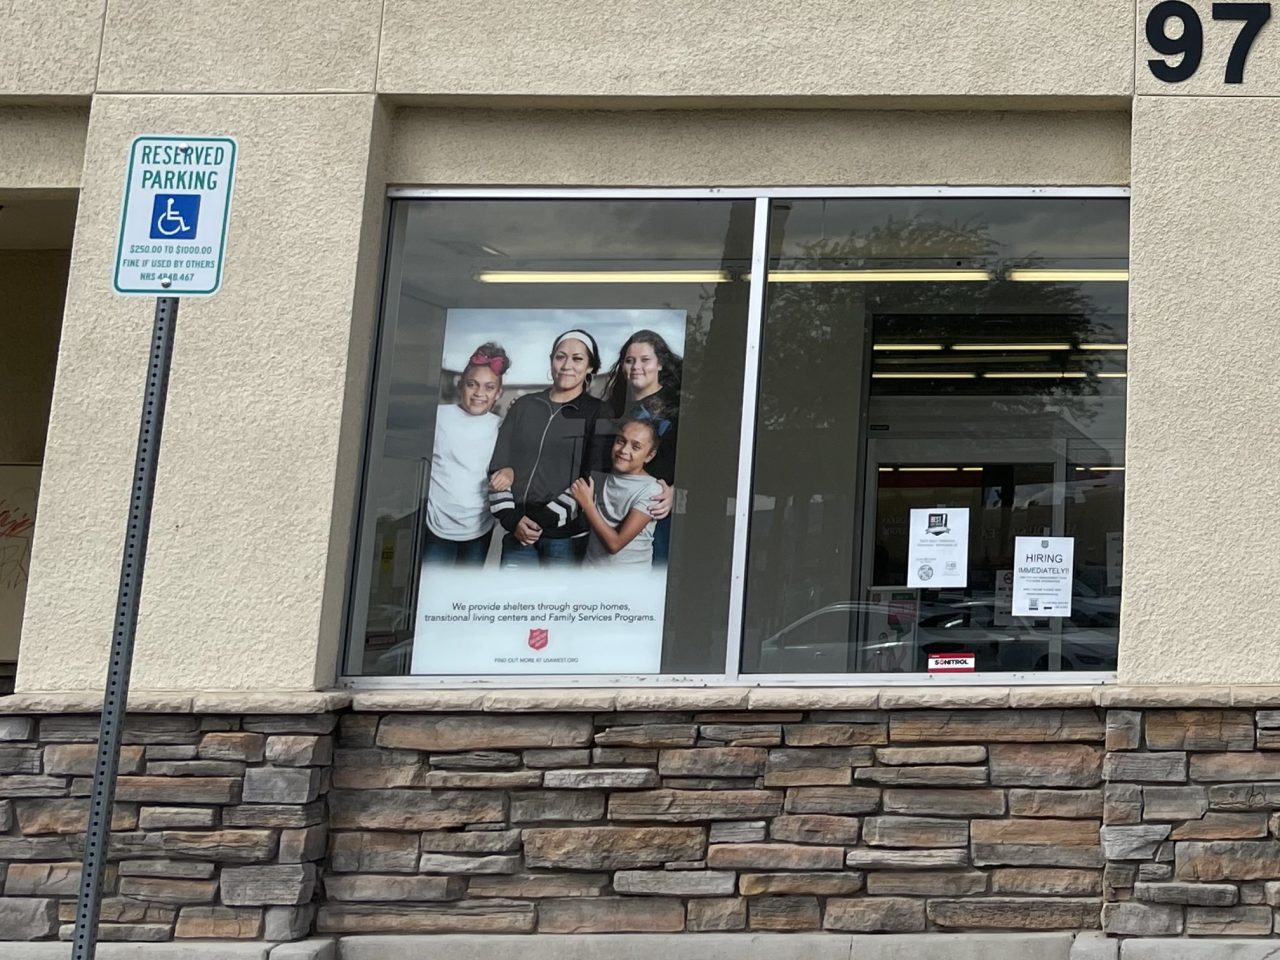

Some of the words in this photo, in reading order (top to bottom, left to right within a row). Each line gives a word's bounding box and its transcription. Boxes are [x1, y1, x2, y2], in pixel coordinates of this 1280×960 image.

[141, 145, 224, 165] RESERVED
[141, 170, 218, 190] PARKING
[130, 245, 162, 254] $250.00
[164, 246, 174, 254] TO
[176, 246, 212, 255] $1000.00
[122, 259, 139, 267] FINE
[142, 259, 149, 268] IF
[151, 259, 172, 268] USED
[173, 260, 184, 268] BY
[186, 260, 215, 269] OTHERS
[140, 272, 156, 281] NRS
[1026, 553, 1064, 563] HIRING
[452, 602, 466, 610] We
[468, 602, 501, 613] provide
[503, 602, 535, 610] shelters
[537, 602, 570, 613] through
[572, 603, 598, 613] group
[600, 602, 631, 611] homes,
[424, 613, 470, 621] transitional
[473, 613, 495, 623] living
[530, 613, 546, 621] and
[549, 613, 576, 623] Family
[578, 613, 612, 621] Services
[614, 613, 656, 623] Programs.
